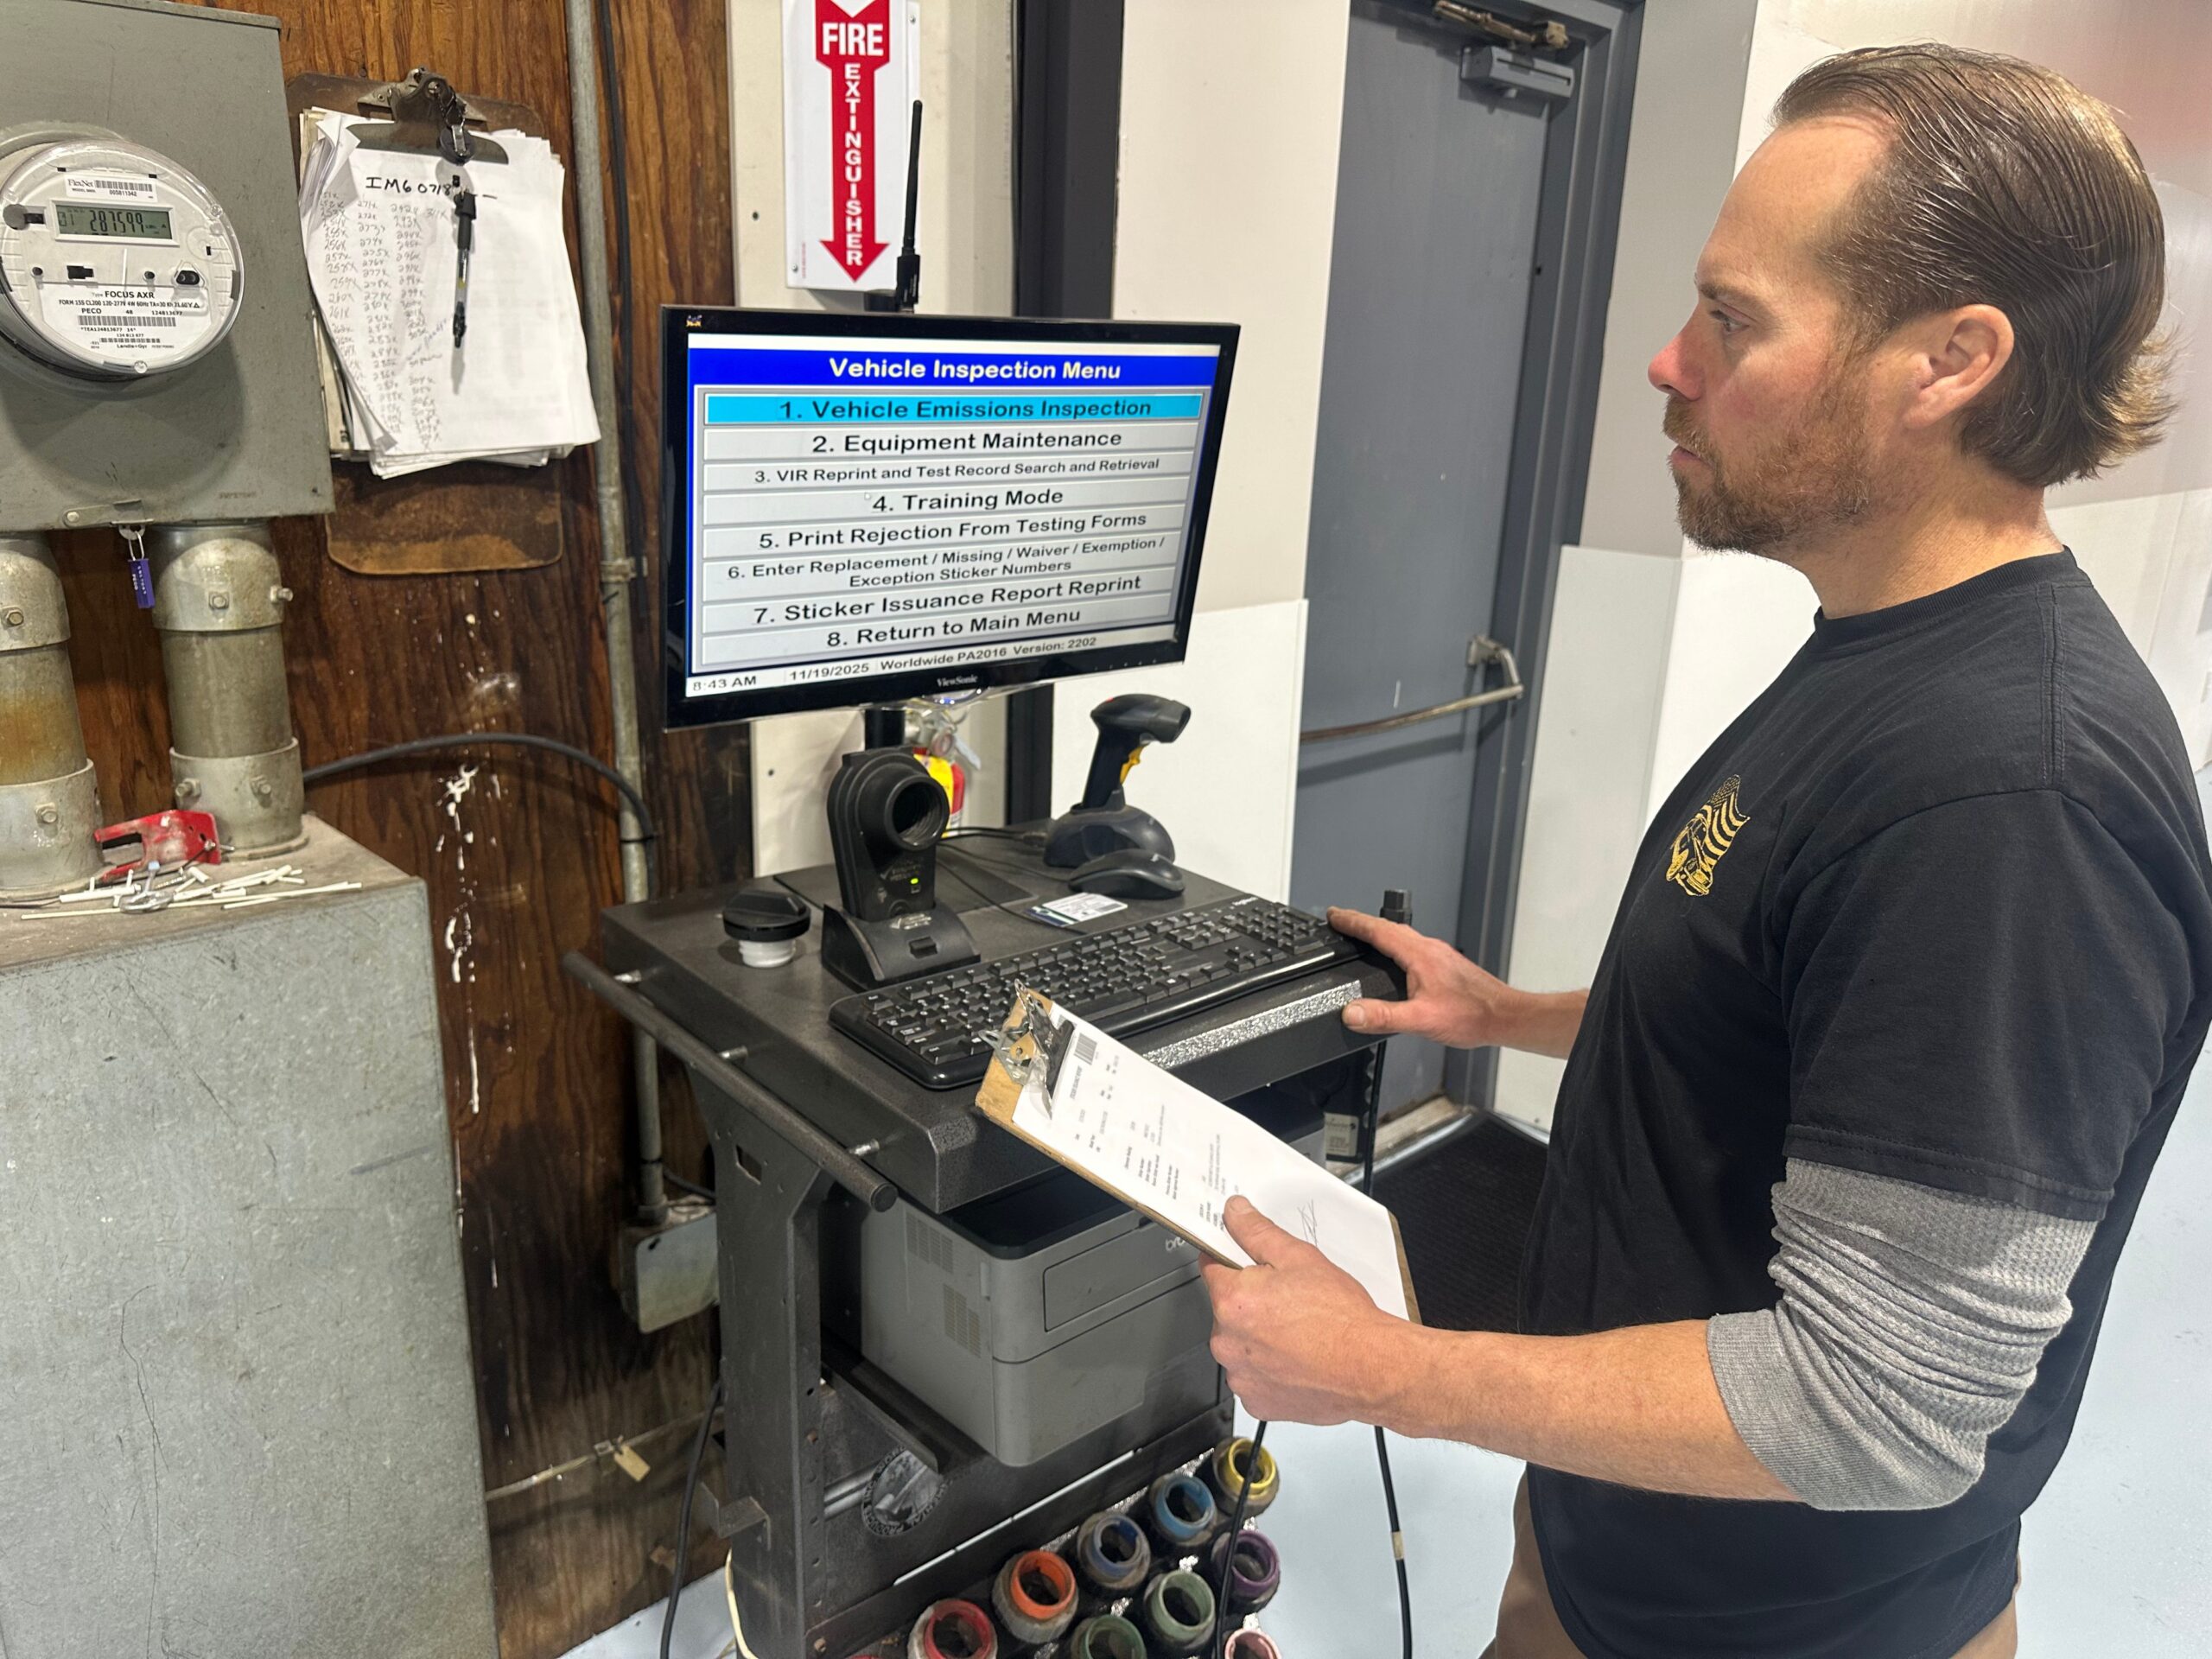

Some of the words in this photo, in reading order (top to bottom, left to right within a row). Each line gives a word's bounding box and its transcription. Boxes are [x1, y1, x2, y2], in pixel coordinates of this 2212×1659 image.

[822, 22, 885, 57] FIRE
[843, 63, 863, 266] EXTINGUISHER
[89, 210, 144, 233] 287599
[829, 357, 925, 378] Vehicle
[933, 359, 1056, 383] Inspection
[1062, 361, 1121, 379] Menu
[779, 401, 802, 419] 1.
[812, 400, 908, 418] Vehicle
[916, 400, 1034, 418] Emissions
[1040, 399, 1151, 420] Inspection
[811, 435, 835, 454] 2.
[843, 433, 976, 454] Equipment
[982, 432, 1122, 449] Maintenance
[754, 471, 771, 483] 3.
[777, 470, 808, 482] VIR
[813, 467, 876, 482] Reprint
[881, 467, 912, 479] and
[916, 465, 951, 478] Test
[955, 462, 1010, 476] Record
[1014, 461, 1066, 474] Search
[1069, 461, 1096, 473] and
[1099, 458, 1160, 473] Retrieval
[872, 495, 894, 512] 4.
[902, 492, 998, 511] Training
[1005, 488, 1064, 506] Mode
[760, 533, 779, 549] 5.
[788, 530, 844, 546] Print
[851, 524, 952, 545] Rejection
[959, 520, 1010, 537] From
[1016, 517, 1086, 533] Testing
[1091, 514, 1147, 529] Forms
[728, 567, 746, 579] 6.
[753, 563, 805, 577] Enter
[810, 553, 929, 574] Replacement
[942, 550, 1003, 564] Missing
[1017, 544, 1070, 559] Waiver
[1082, 537, 1156, 555] Exemption
[850, 572, 935, 588] Exception
[940, 567, 998, 581] Sticker
[1002, 560, 1071, 575] Numbers
[754, 608, 776, 624] 7.
[785, 600, 875, 621] Sticker
[882, 593, 984, 613] Issuance
[991, 582, 1064, 603] Report
[1069, 575, 1141, 595] Reprint
[827, 632, 848, 647] 8.
[857, 624, 935, 645] Return
[943, 620, 963, 636] to
[970, 615, 1020, 632] Main
[1027, 608, 1081, 626] Menu
[790, 662, 869, 681] 11/19/2025
[880, 653, 954, 671] Worldwide
[957, 647, 1007, 662] PA2016
[1013, 643, 1065, 656] Version:
[1068, 637, 1096, 649] 2202
[693, 678, 728, 692] 8:43
[732, 676, 757, 688] AM
[937, 674, 979, 688] ViewSonic
